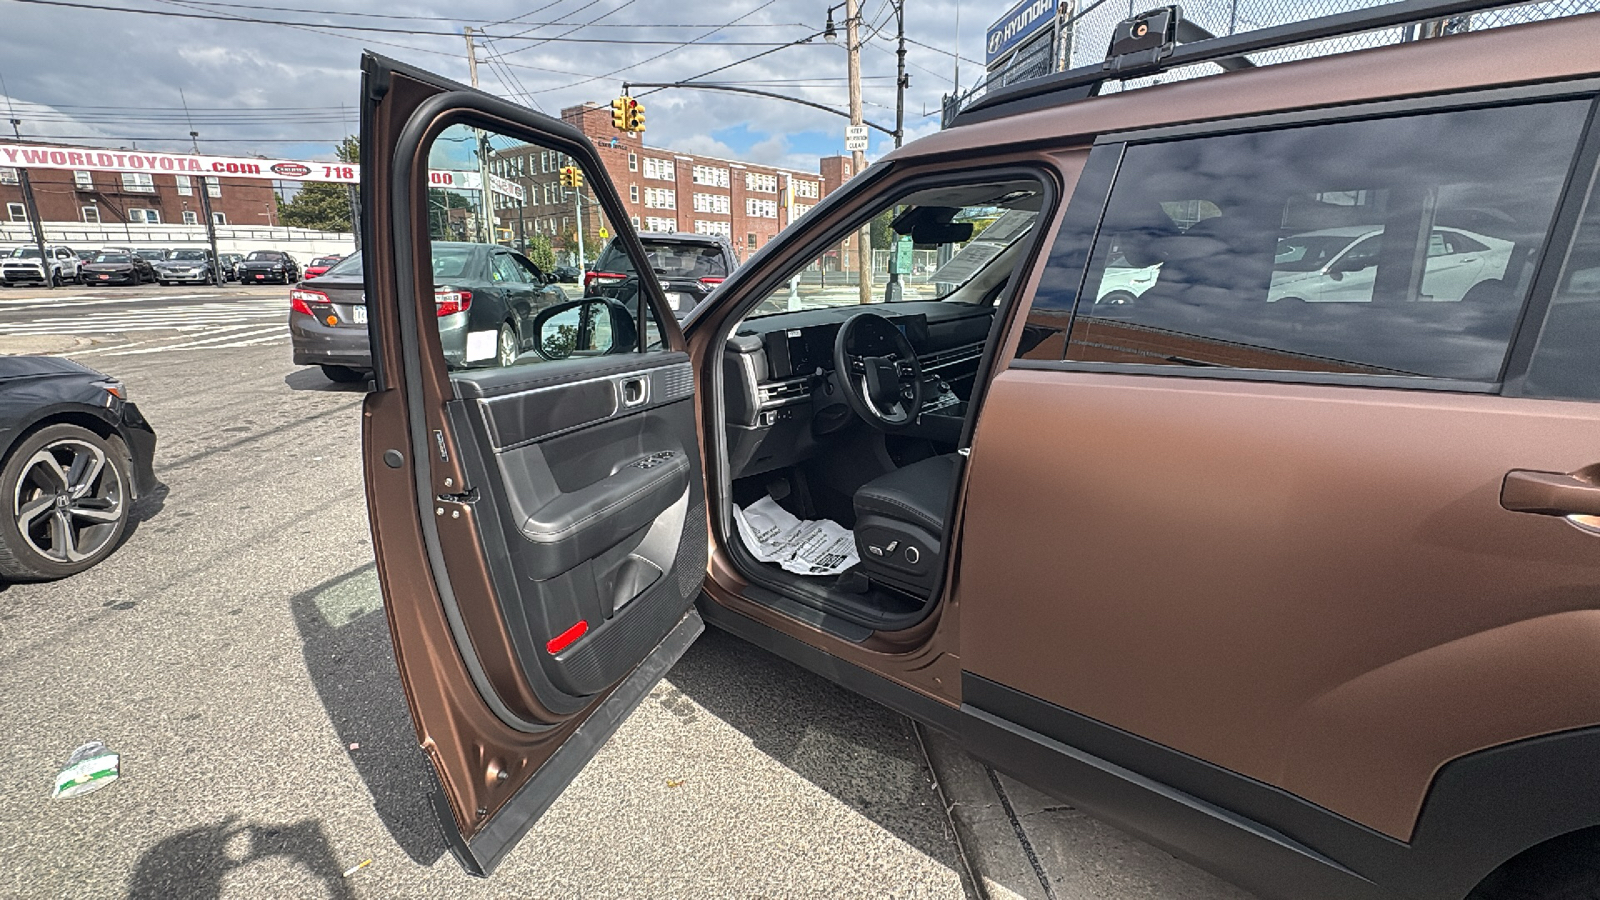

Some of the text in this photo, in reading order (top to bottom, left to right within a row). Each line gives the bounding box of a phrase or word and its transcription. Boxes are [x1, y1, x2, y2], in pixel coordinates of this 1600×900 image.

[0, 148, 260, 175] YWORLDTOYOTA.com
[322, 166, 354, 179] 718
[428, 172, 453, 185] 00
